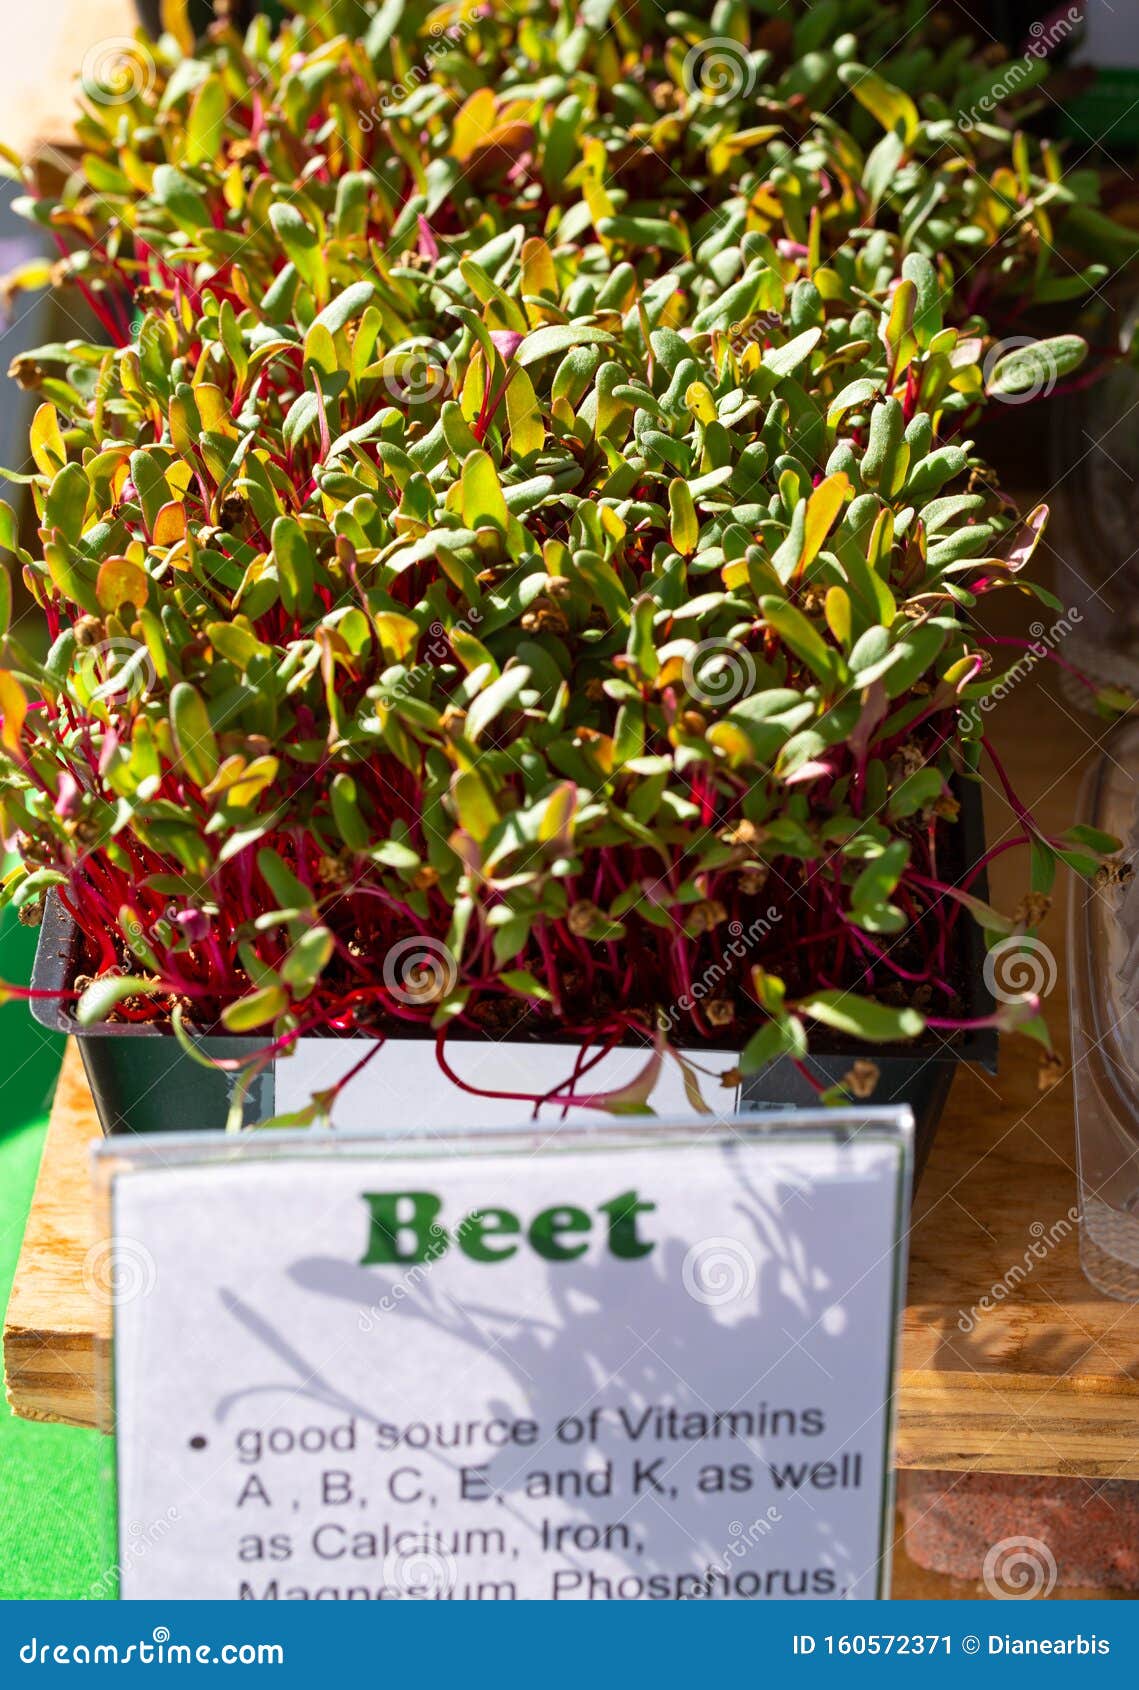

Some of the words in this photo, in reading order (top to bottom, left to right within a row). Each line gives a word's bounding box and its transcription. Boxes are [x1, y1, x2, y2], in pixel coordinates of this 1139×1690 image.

[360, 1189, 657, 1264] Beet
[236, 1417, 356, 1464] good
[377, 1418, 540, 1452] source
[556, 1407, 602, 1445] of
[618, 1402, 825, 1442] Vitamins
[237, 1473, 271, 1508] A
[322, 1469, 368, 1509] B,
[388, 1466, 437, 1508] C,
[460, 1464, 505, 1506] E,
[526, 1461, 612, 1498] and
[633, 1457, 679, 1500] K,
[698, 1462, 753, 1493] as
[768, 1453, 863, 1489] well
[238, 1532, 293, 1562] as
[312, 1521, 520, 1560] Calcium,
[543, 1519, 644, 1556] Iron,
